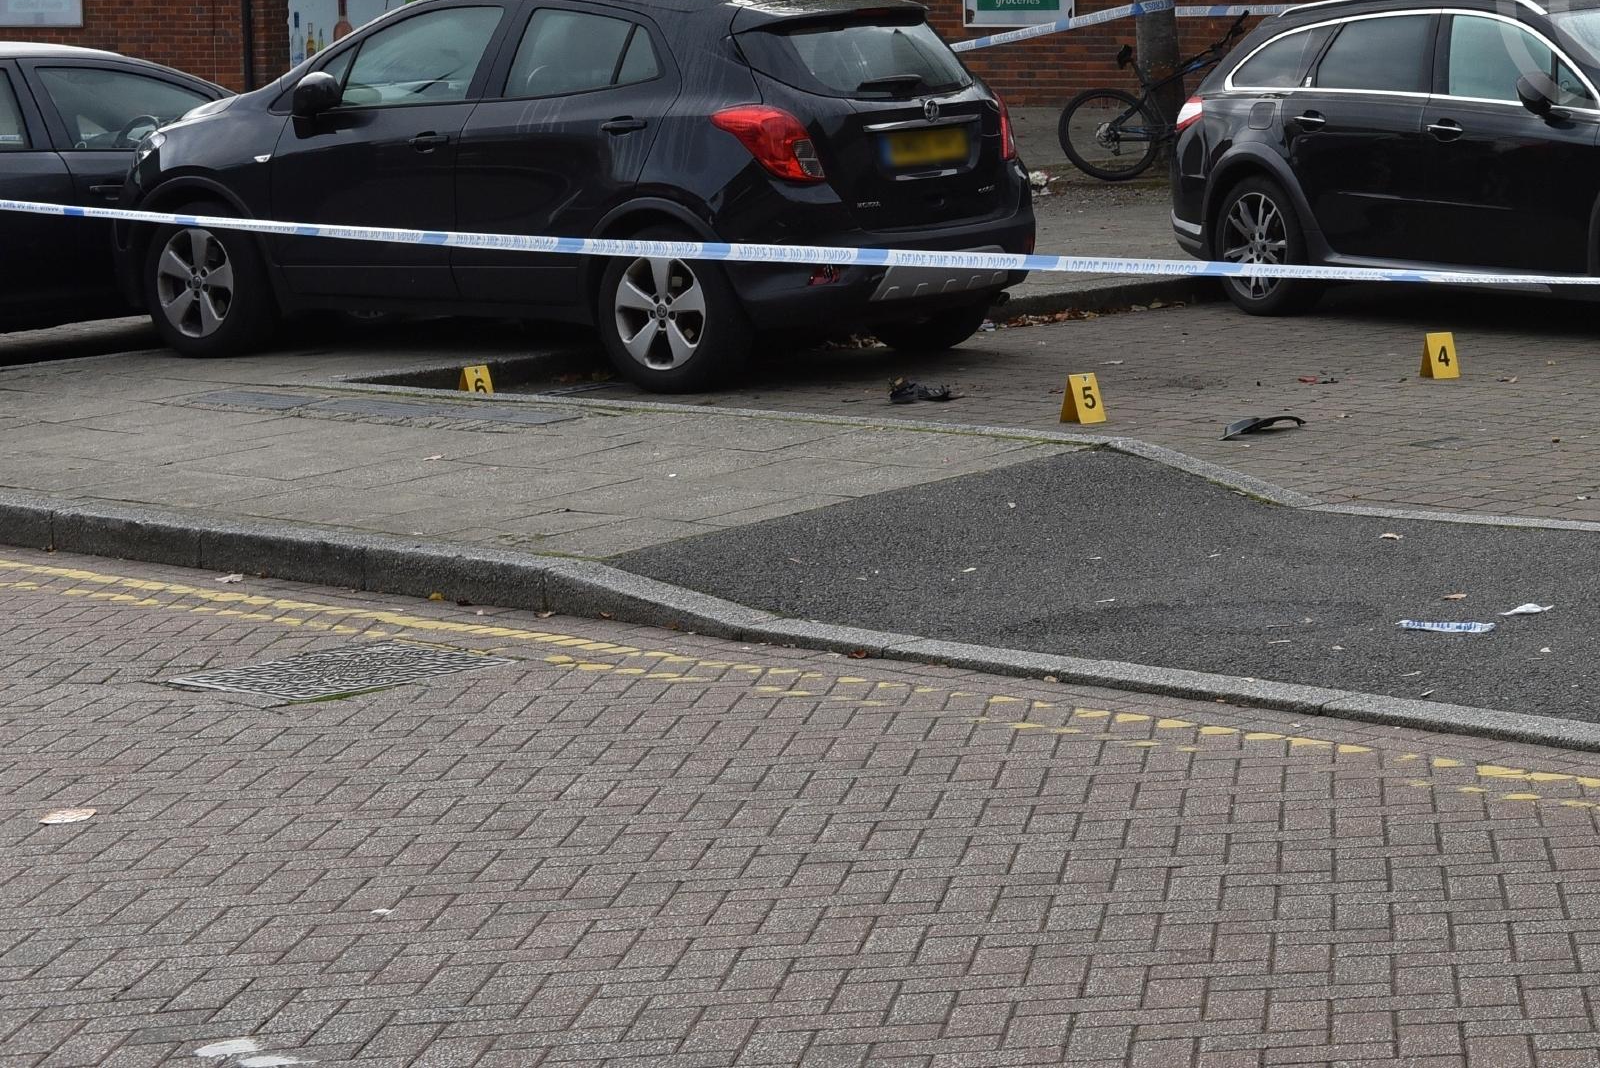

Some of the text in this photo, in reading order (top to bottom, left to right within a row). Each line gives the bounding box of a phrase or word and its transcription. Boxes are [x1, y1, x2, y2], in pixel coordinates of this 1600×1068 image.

[1438, 345, 1450, 367] 4
[474, 378, 488, 392] 6
[1082, 386, 1096, 409] 5
